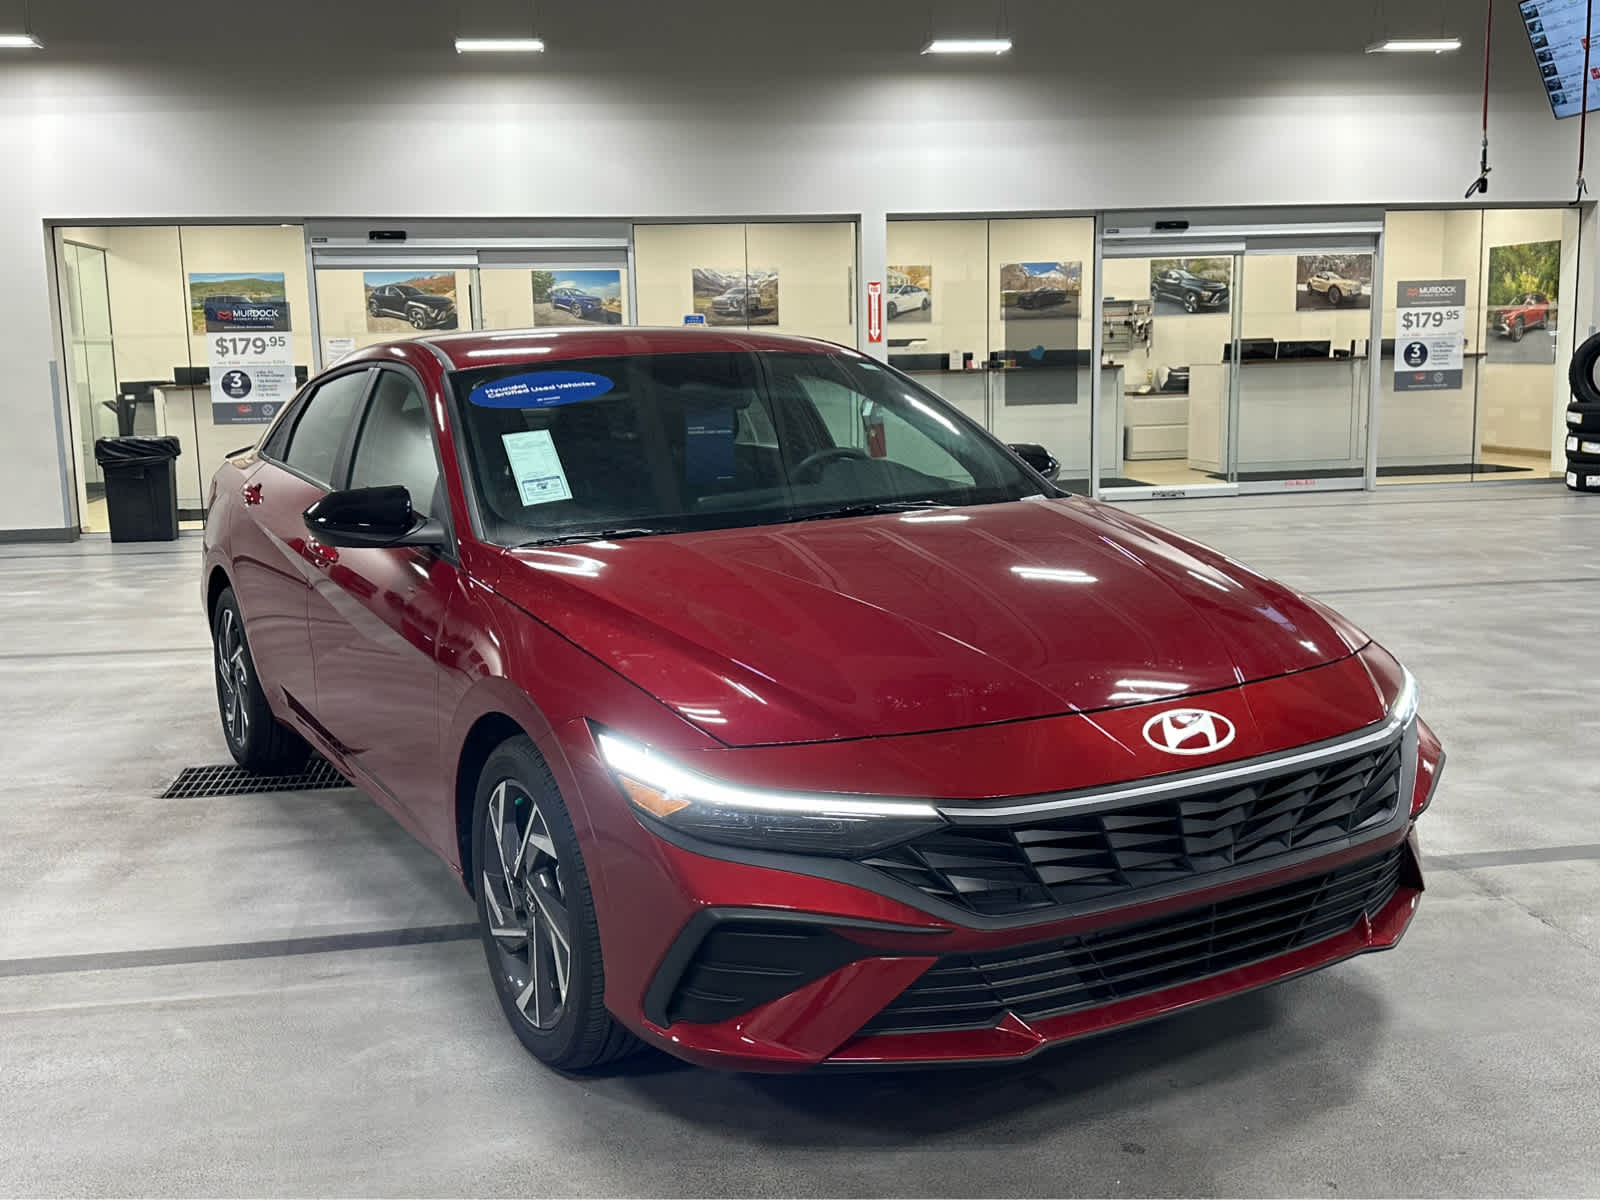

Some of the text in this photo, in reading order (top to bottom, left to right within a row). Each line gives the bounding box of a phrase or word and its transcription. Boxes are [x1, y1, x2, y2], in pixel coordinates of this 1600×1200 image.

[232, 309, 279, 317] MURDOCK
[1402, 310, 1460, 331] $179.95
[215, 336, 286, 358] $179.95
[1410, 343, 1421, 358] 3
[230, 372, 242, 388] 3
[530, 384, 555, 392] Used
[556, 381, 596, 389] Vehicles
